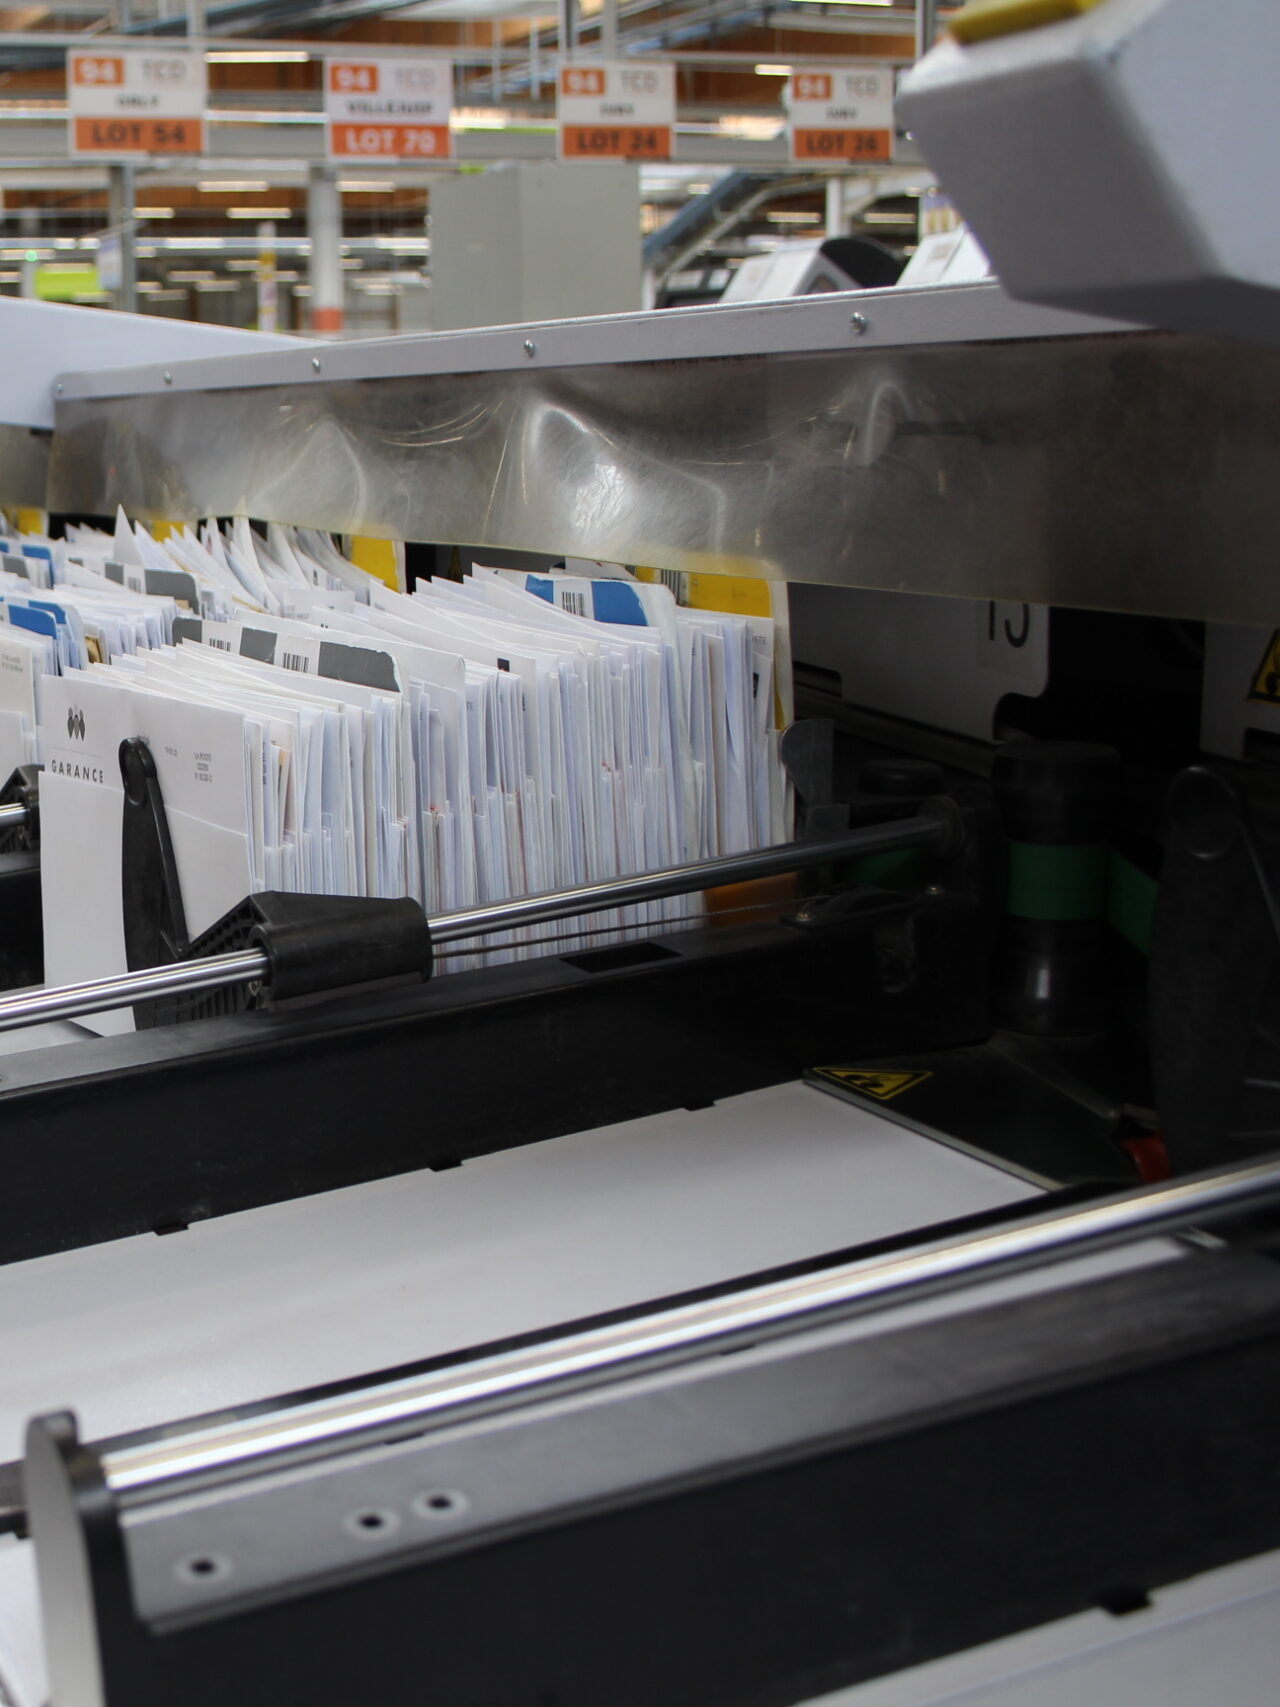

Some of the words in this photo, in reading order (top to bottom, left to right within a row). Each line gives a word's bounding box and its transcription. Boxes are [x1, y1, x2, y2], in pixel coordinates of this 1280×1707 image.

[80, 59, 116, 82] 94
[140, 59, 187, 82] TCD
[336, 67, 370, 91] 94
[568, 71, 598, 94] 94
[621, 69, 659, 93] TCD
[799, 75, 825, 97] 94
[91, 122, 141, 144] LOT
[154, 122, 186, 144] 54
[345, 128, 397, 153] LOT
[403, 128, 436, 153] 70
[577, 129, 621, 152] LOT
[806, 133, 845, 154] LOT
[51, 760, 104, 784] GARANCE
